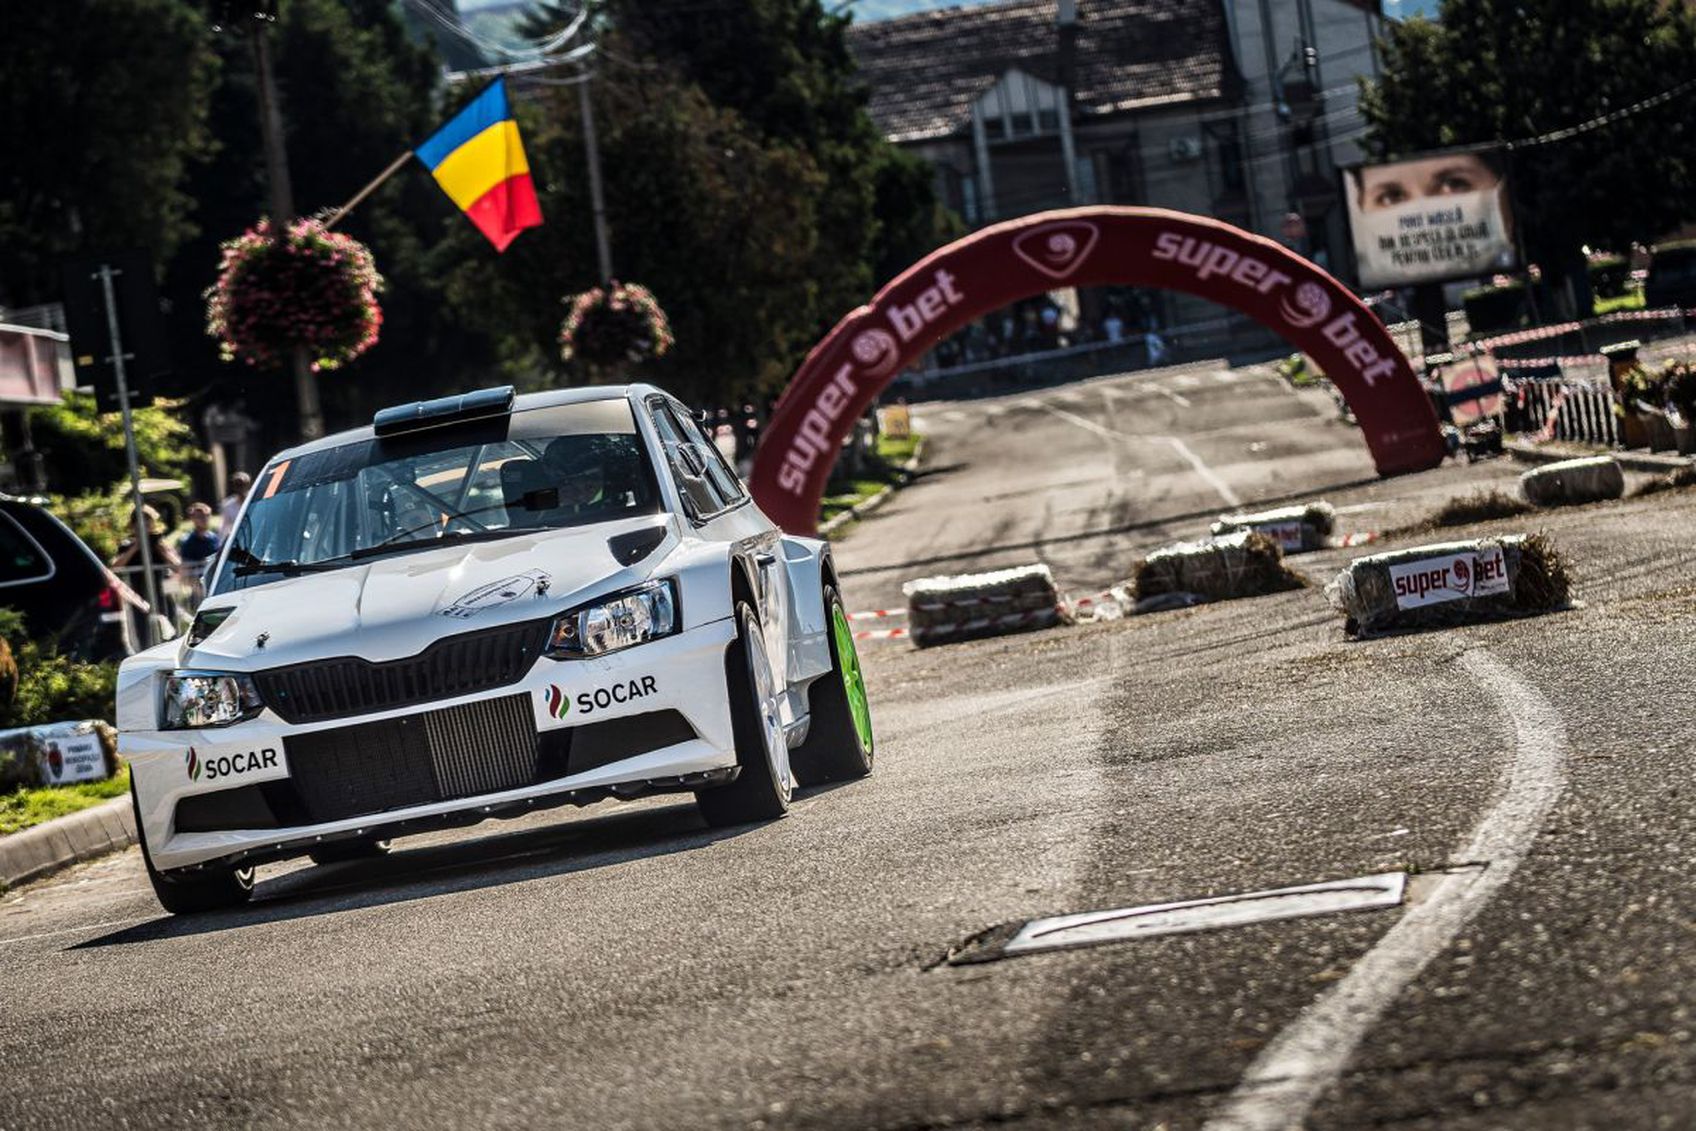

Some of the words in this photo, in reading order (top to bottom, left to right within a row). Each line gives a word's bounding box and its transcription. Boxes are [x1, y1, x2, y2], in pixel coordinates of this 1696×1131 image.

[1153, 232, 1292, 295] super
[1321, 312, 1397, 387] bet
[777, 363, 858, 496] super
[887, 269, 964, 342] bet
[262, 460, 292, 499] 1
[1395, 568, 1450, 599] super
[1472, 552, 1504, 582] bet
[577, 675, 658, 714] SOCAR
[205, 748, 278, 780] SOCAR
